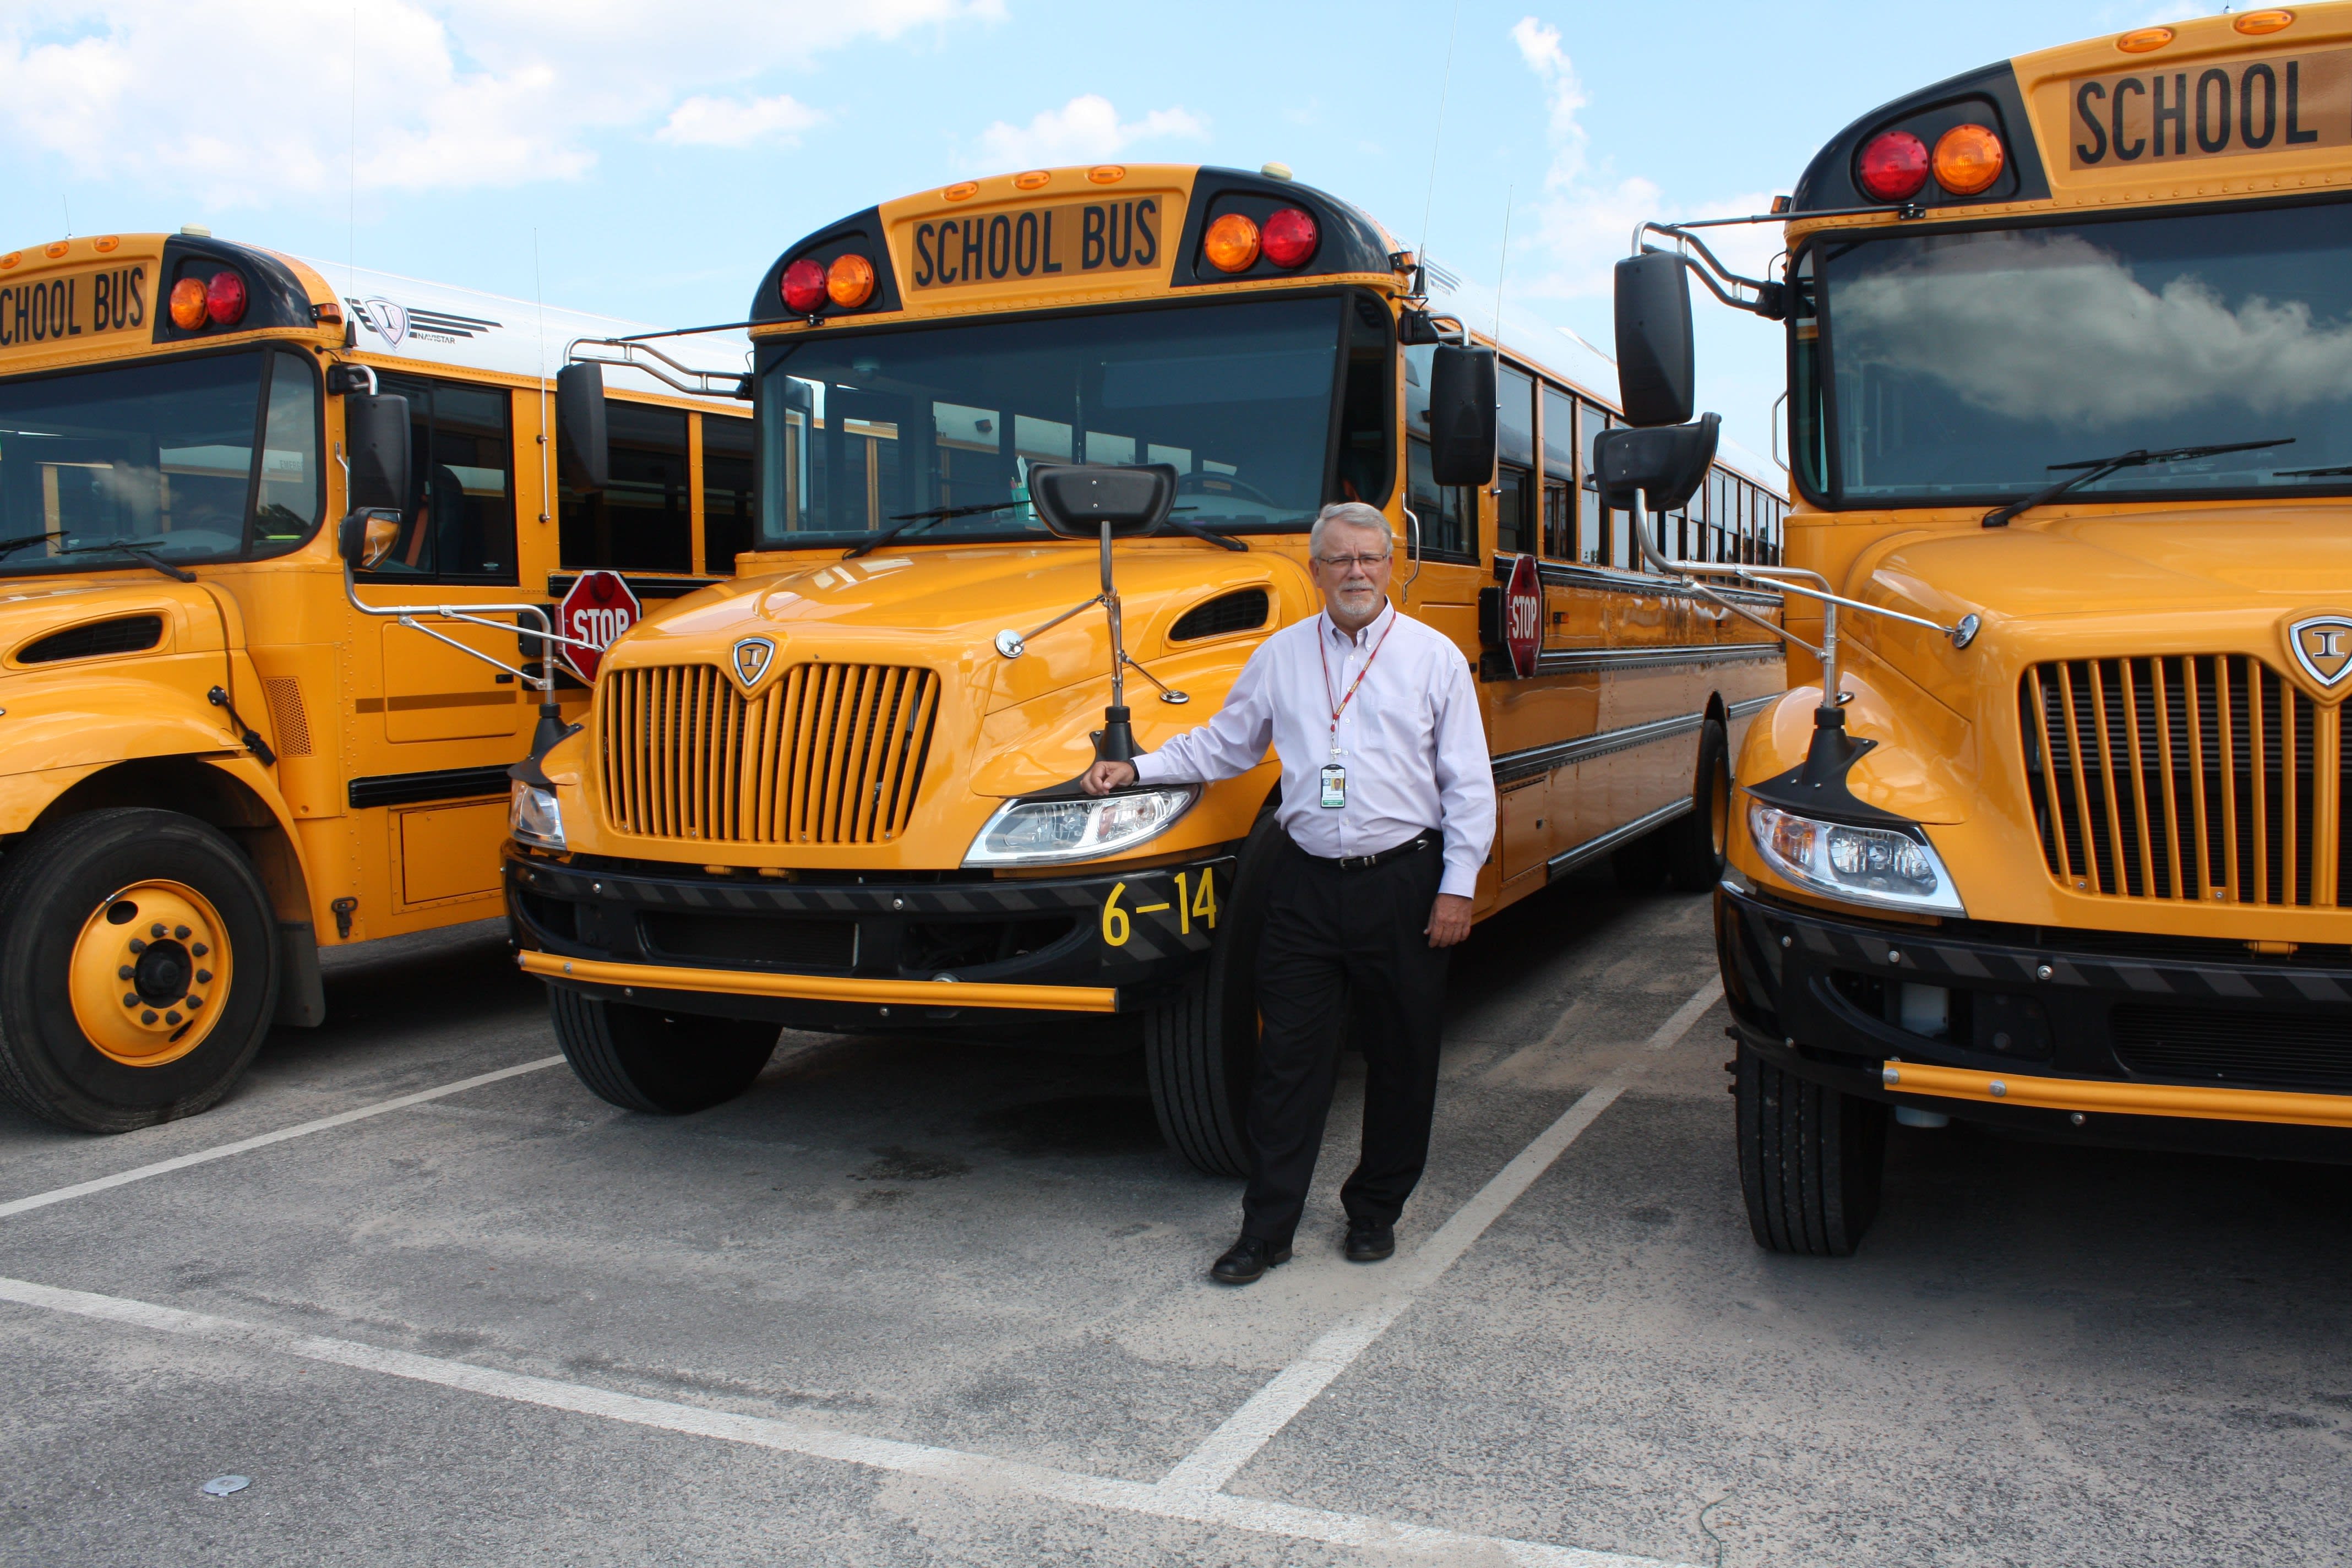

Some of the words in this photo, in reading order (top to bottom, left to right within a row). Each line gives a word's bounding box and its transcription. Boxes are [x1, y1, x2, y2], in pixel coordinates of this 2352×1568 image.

[2076, 61, 2318, 165] SCHOOL
[915, 211, 1062, 287] SCHOOL
[1082, 199, 1157, 270] BUS
[0, 279, 81, 346] CHOOL
[94, 267, 144, 331] BUS
[418, 332, 456, 344] NAVISTAR
[573, 608, 629, 649] STOP
[1512, 595, 1537, 639] STOP
[1103, 867, 1217, 946] 6-14
